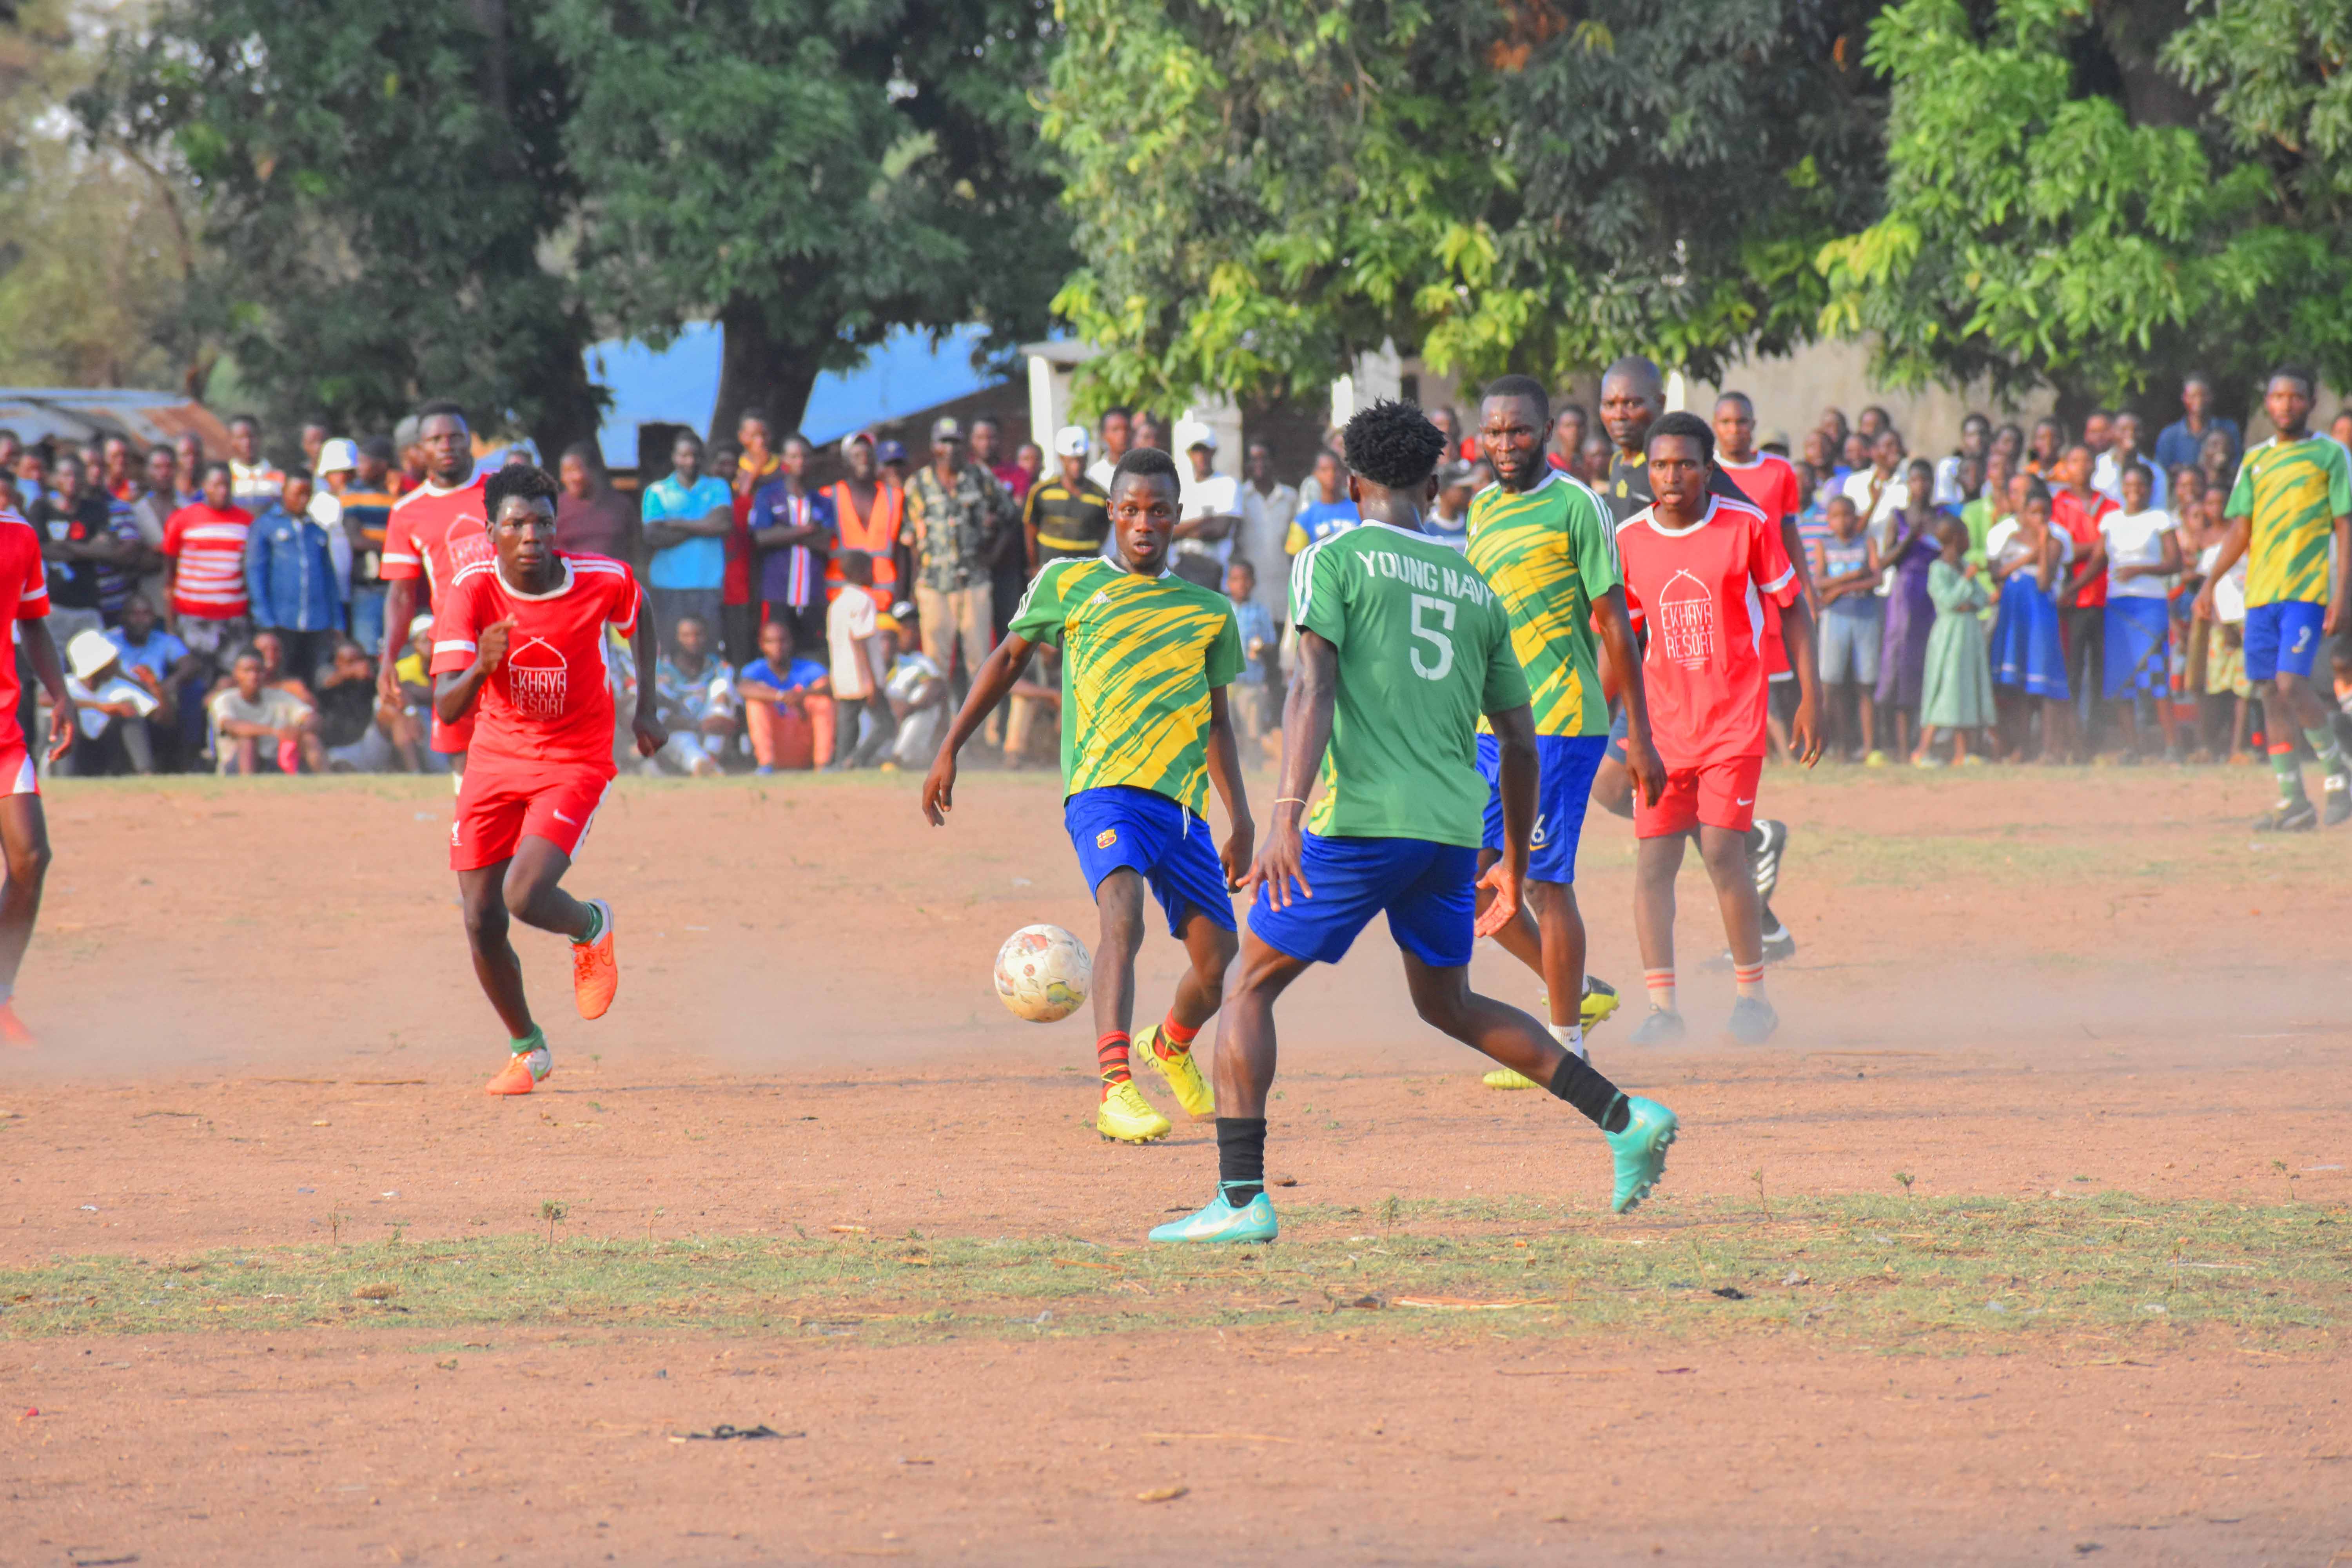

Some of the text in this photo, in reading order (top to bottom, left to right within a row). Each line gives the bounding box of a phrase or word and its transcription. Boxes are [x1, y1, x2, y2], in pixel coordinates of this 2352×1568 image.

[1355, 550, 1494, 612] YOUNG NAVY
[1661, 602, 1713, 630] EKHAYA
[1410, 592, 1456, 681] 5
[1666, 630, 1715, 659] RESORT
[509, 667, 567, 694] EKHAYA
[511, 687, 565, 716] RESORT
[1531, 814, 1545, 844] 6
